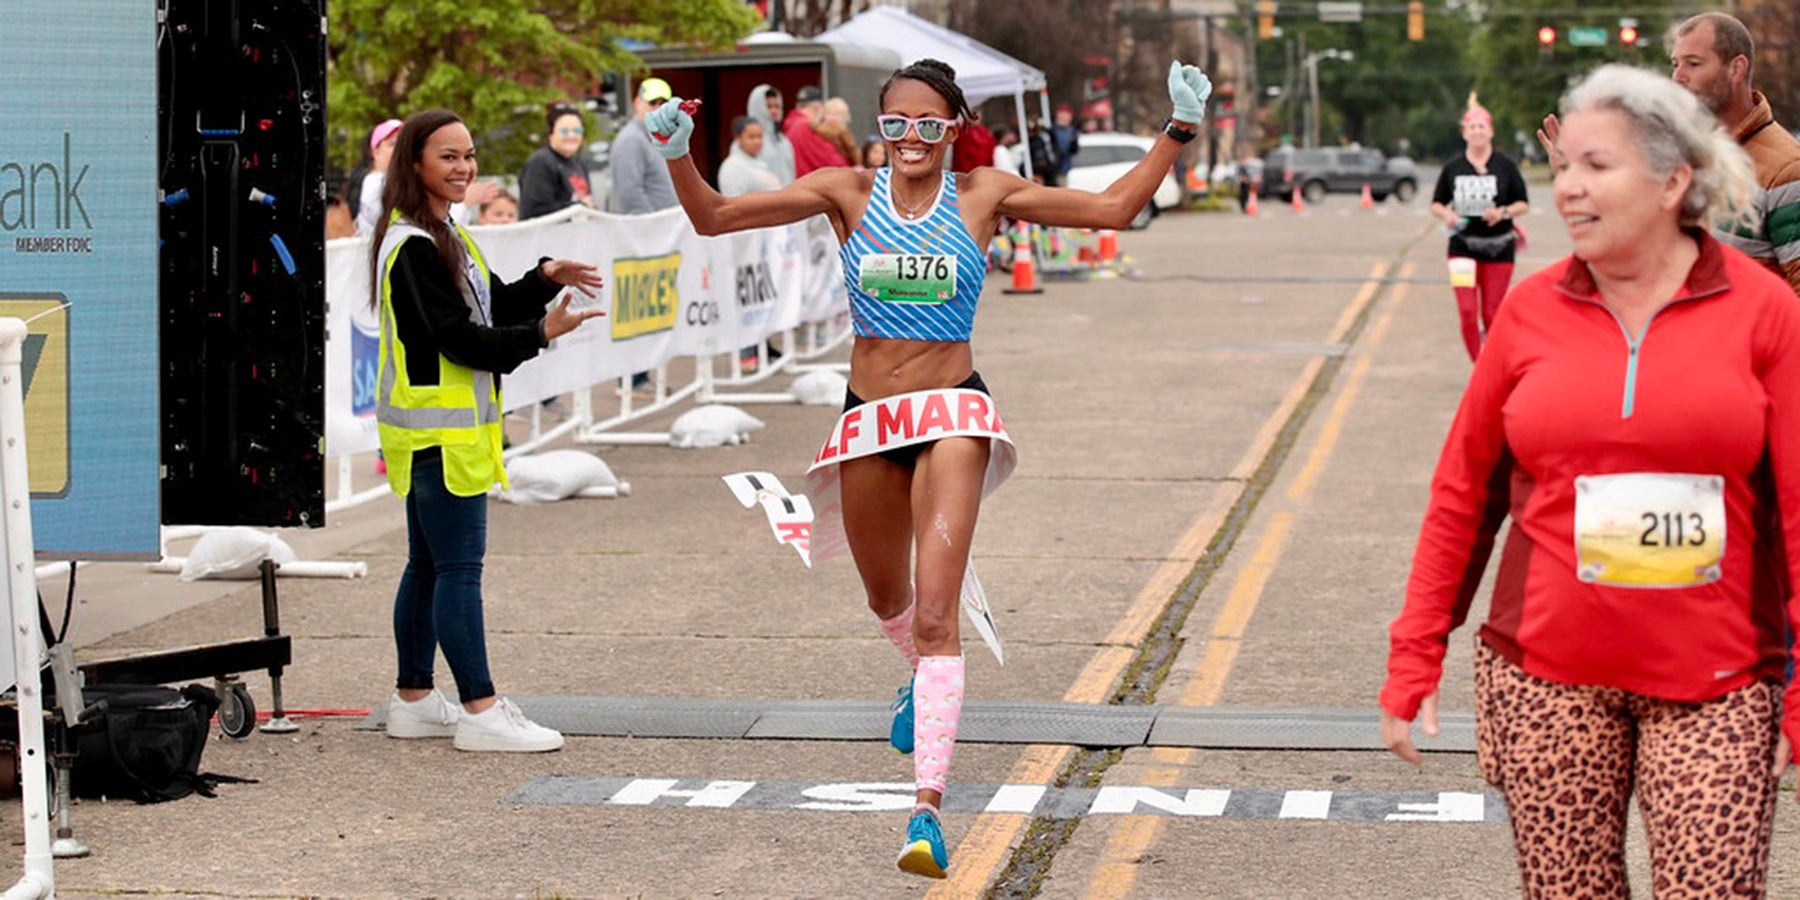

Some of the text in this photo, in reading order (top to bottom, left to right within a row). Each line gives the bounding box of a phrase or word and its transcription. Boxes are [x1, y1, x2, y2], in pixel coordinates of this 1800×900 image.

[16, 237, 93, 253] MEMBER FDIC
[896, 256, 948, 280] 1376
[815, 411, 861, 464] LF
[1640, 512, 1706, 546] 2113
[603, 778, 1485, 822] FINISH
